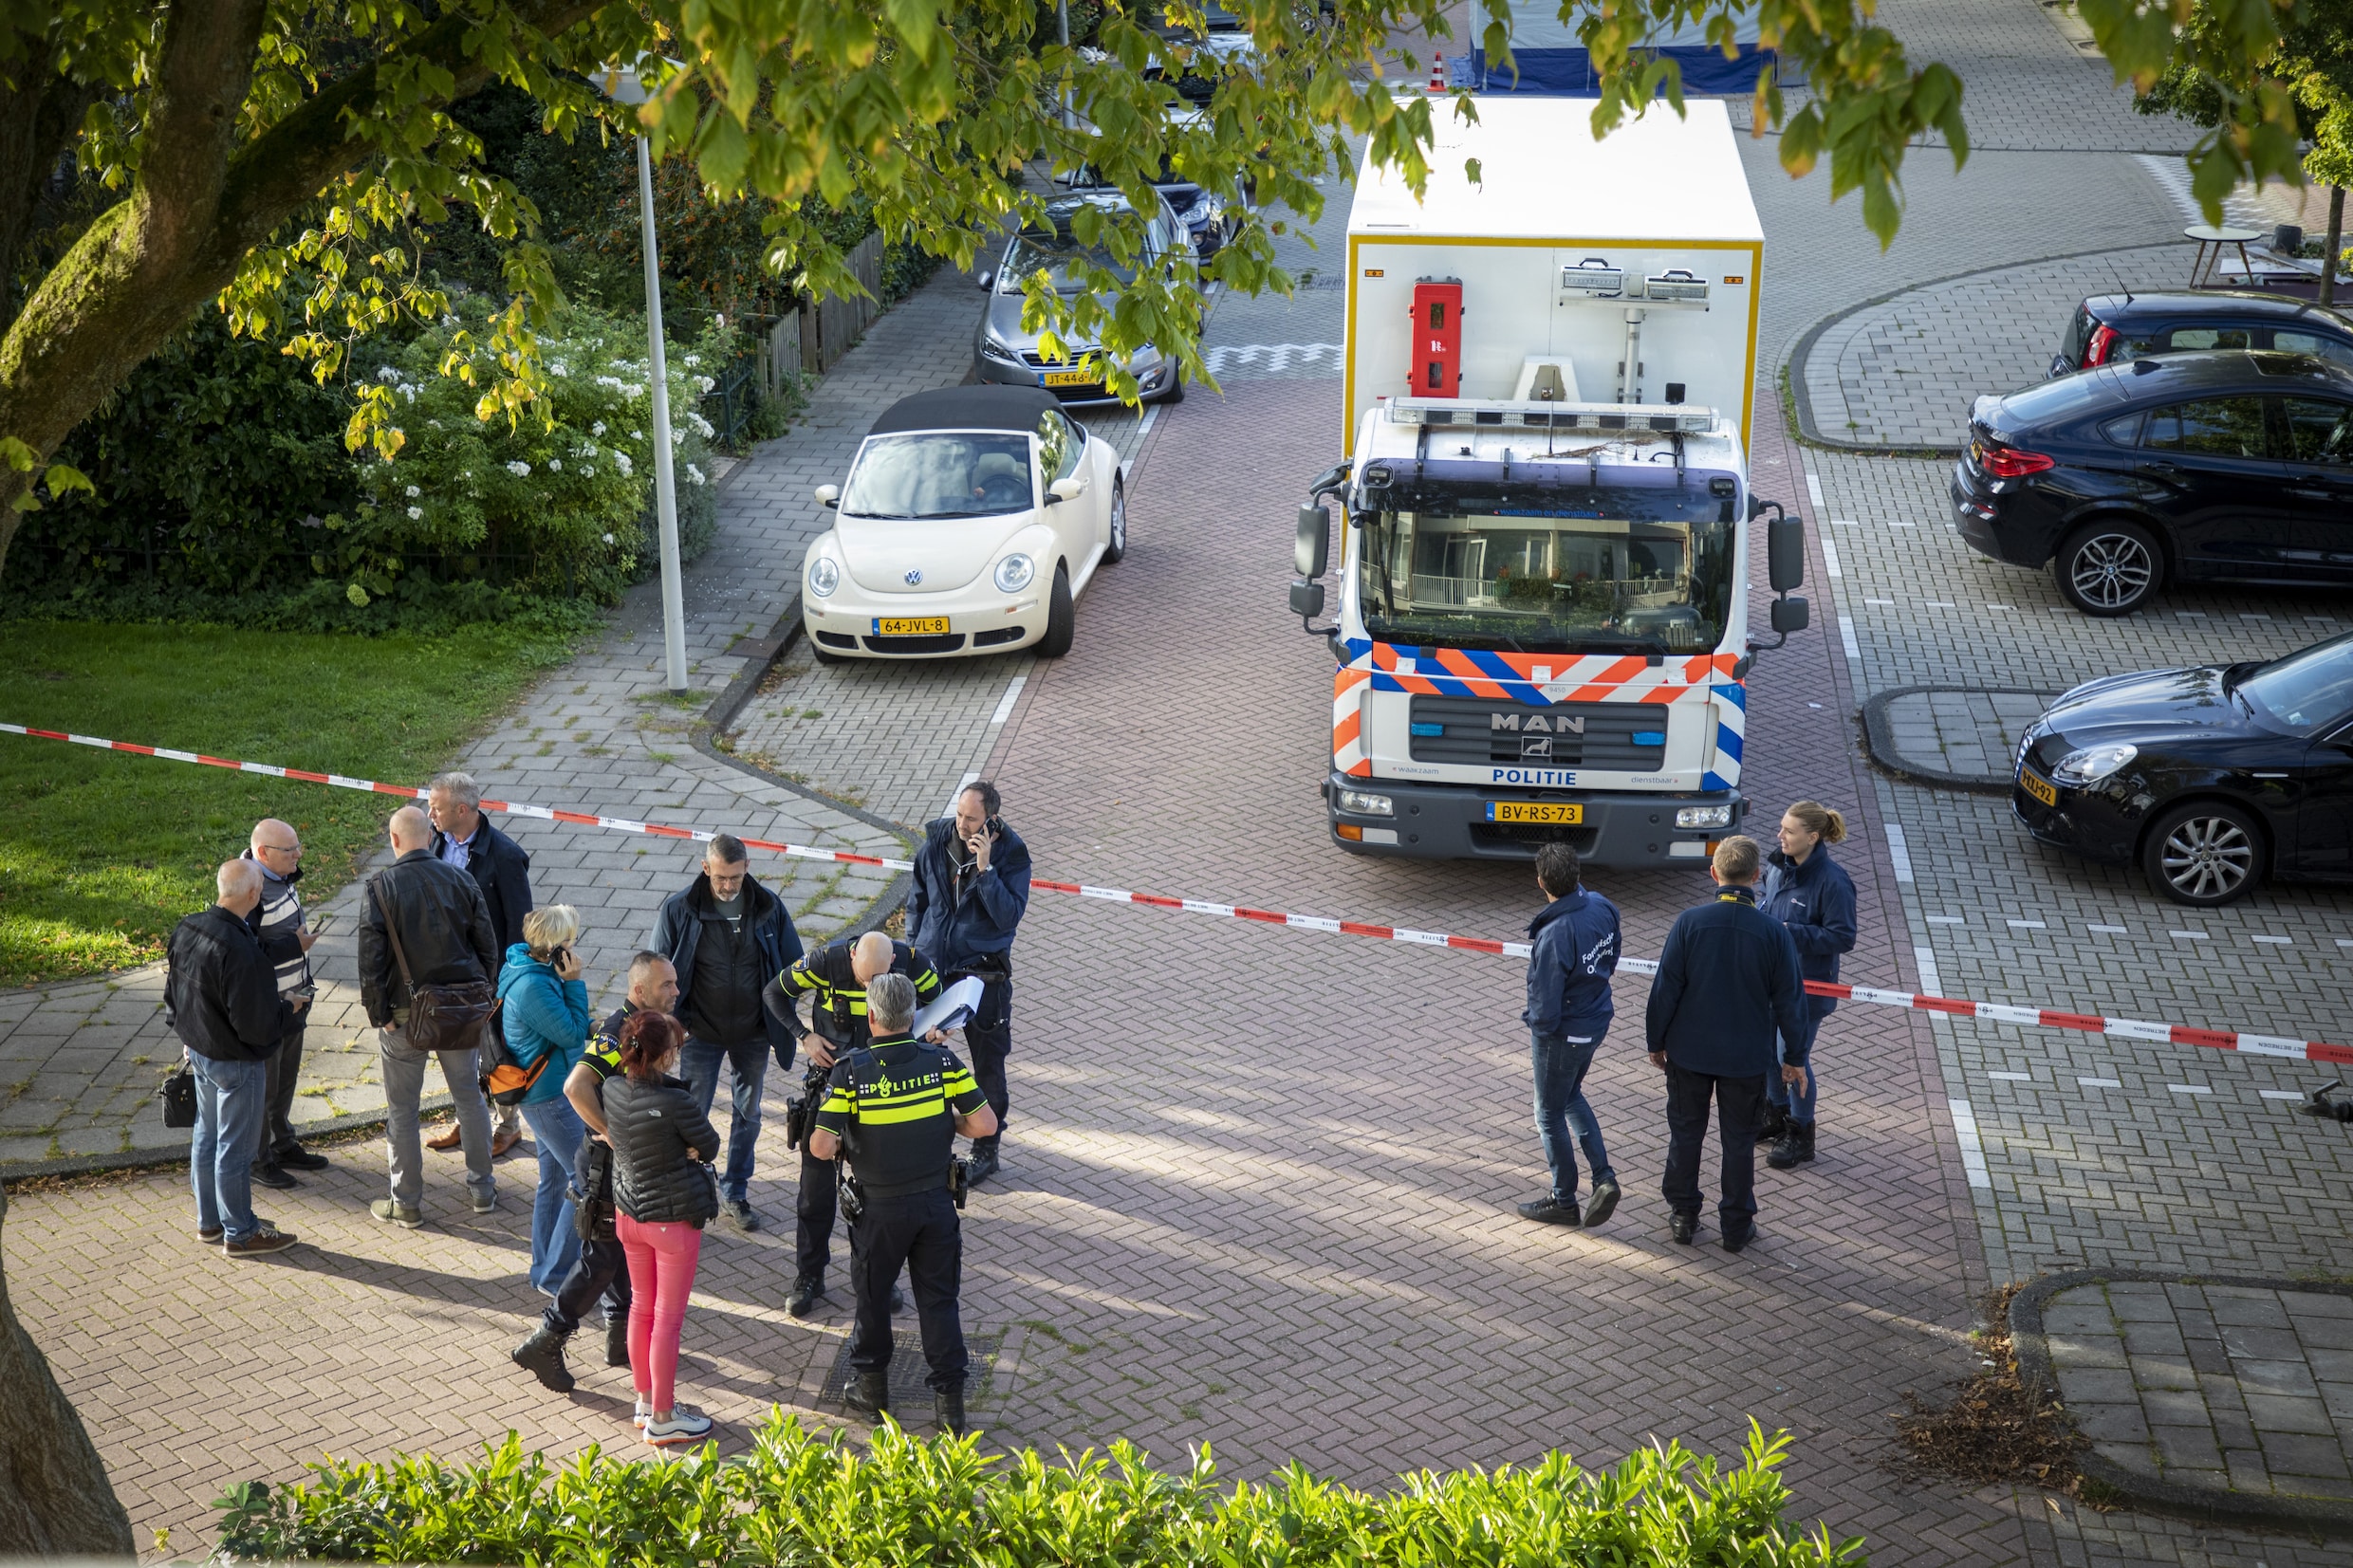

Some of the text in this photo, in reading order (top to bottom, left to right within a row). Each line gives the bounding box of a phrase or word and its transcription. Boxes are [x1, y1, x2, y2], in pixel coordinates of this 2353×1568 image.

[1049, 374, 1090, 383] JT-448-
[885, 620, 942, 632] 64-JVL-8
[1491, 713, 1584, 732] MAN
[1493, 769, 1576, 785] POLITIE
[1503, 806, 1575, 820] BV-RS-73
[2133, 1026, 2165, 1034] BETREDEN
[2258, 1042, 2291, 1050] BETREDEN
[870, 1074, 931, 1098] POLITIE
